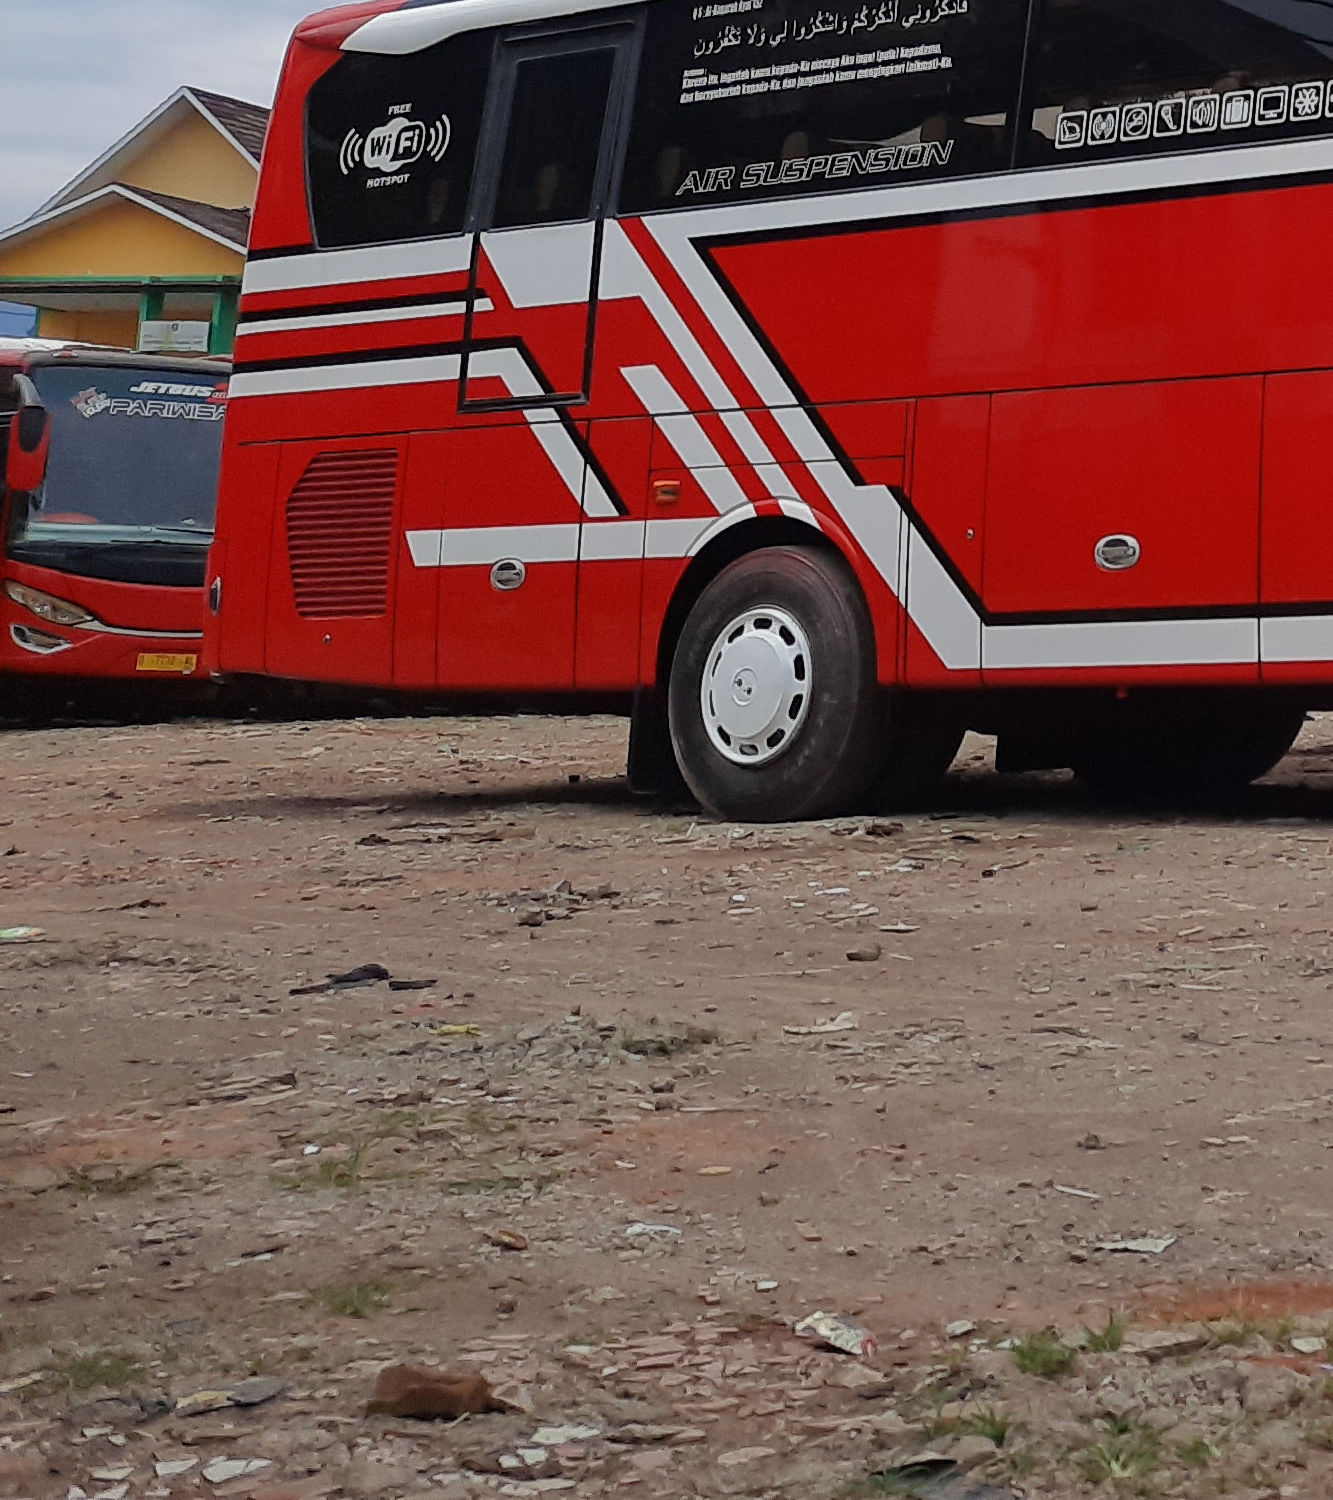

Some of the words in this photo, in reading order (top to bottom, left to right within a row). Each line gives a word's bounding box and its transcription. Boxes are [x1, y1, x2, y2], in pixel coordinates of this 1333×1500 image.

[388, 103, 412, 116] FREE
[675, 165, 736, 196] AIR
[740, 139, 955, 189] SUSPENSION
[366, 173, 411, 189] HOTSPOT
